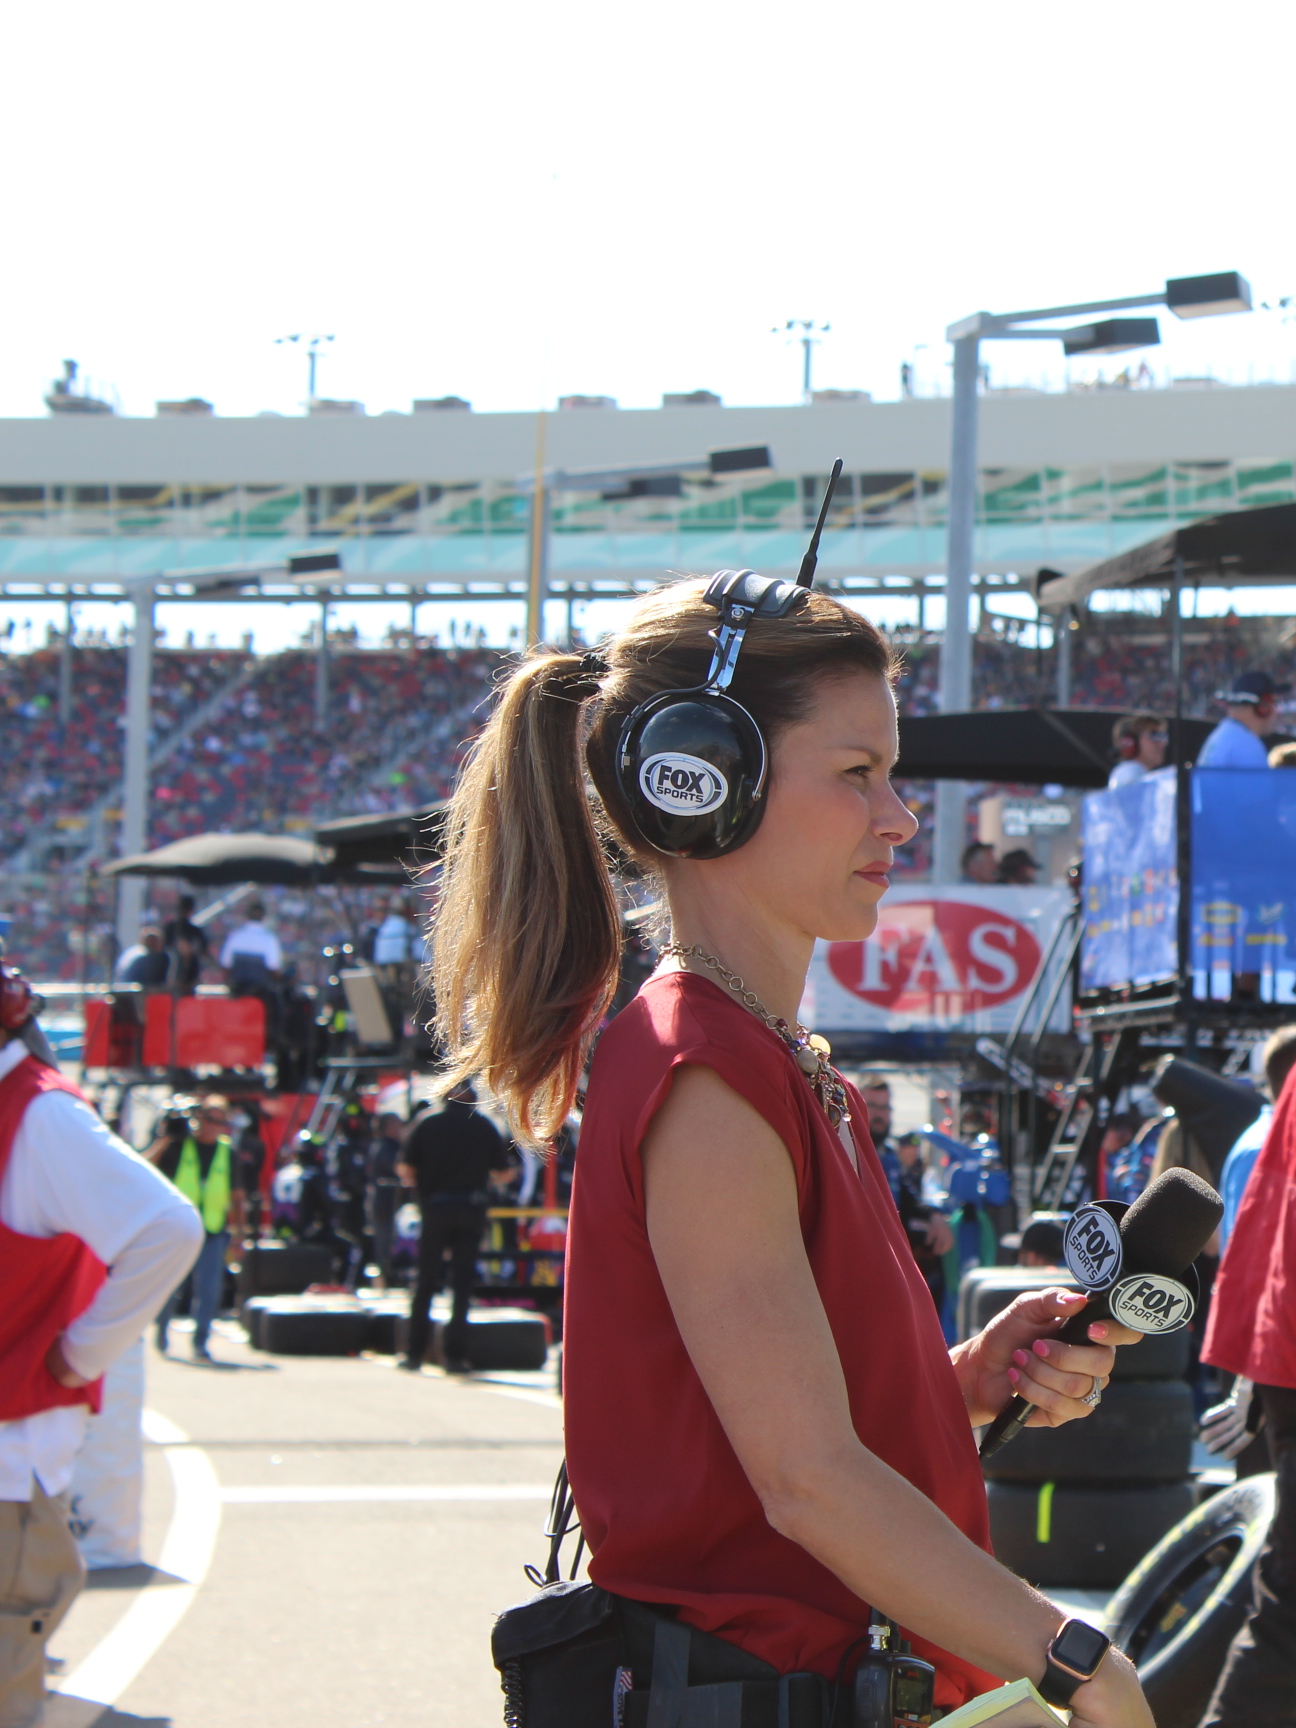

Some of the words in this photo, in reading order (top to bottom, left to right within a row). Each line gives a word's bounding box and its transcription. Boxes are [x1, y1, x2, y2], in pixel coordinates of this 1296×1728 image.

[656, 785, 704, 803] SPORTS
[658, 765, 706, 794] FOX
[856, 921, 1019, 994] FAS
[1069, 1235, 1099, 1281] SPORTS
[1076, 1215, 1116, 1273] FOX
[1119, 1300, 1167, 1328] SPORTS
[1127, 1281, 1184, 1320] FOX
